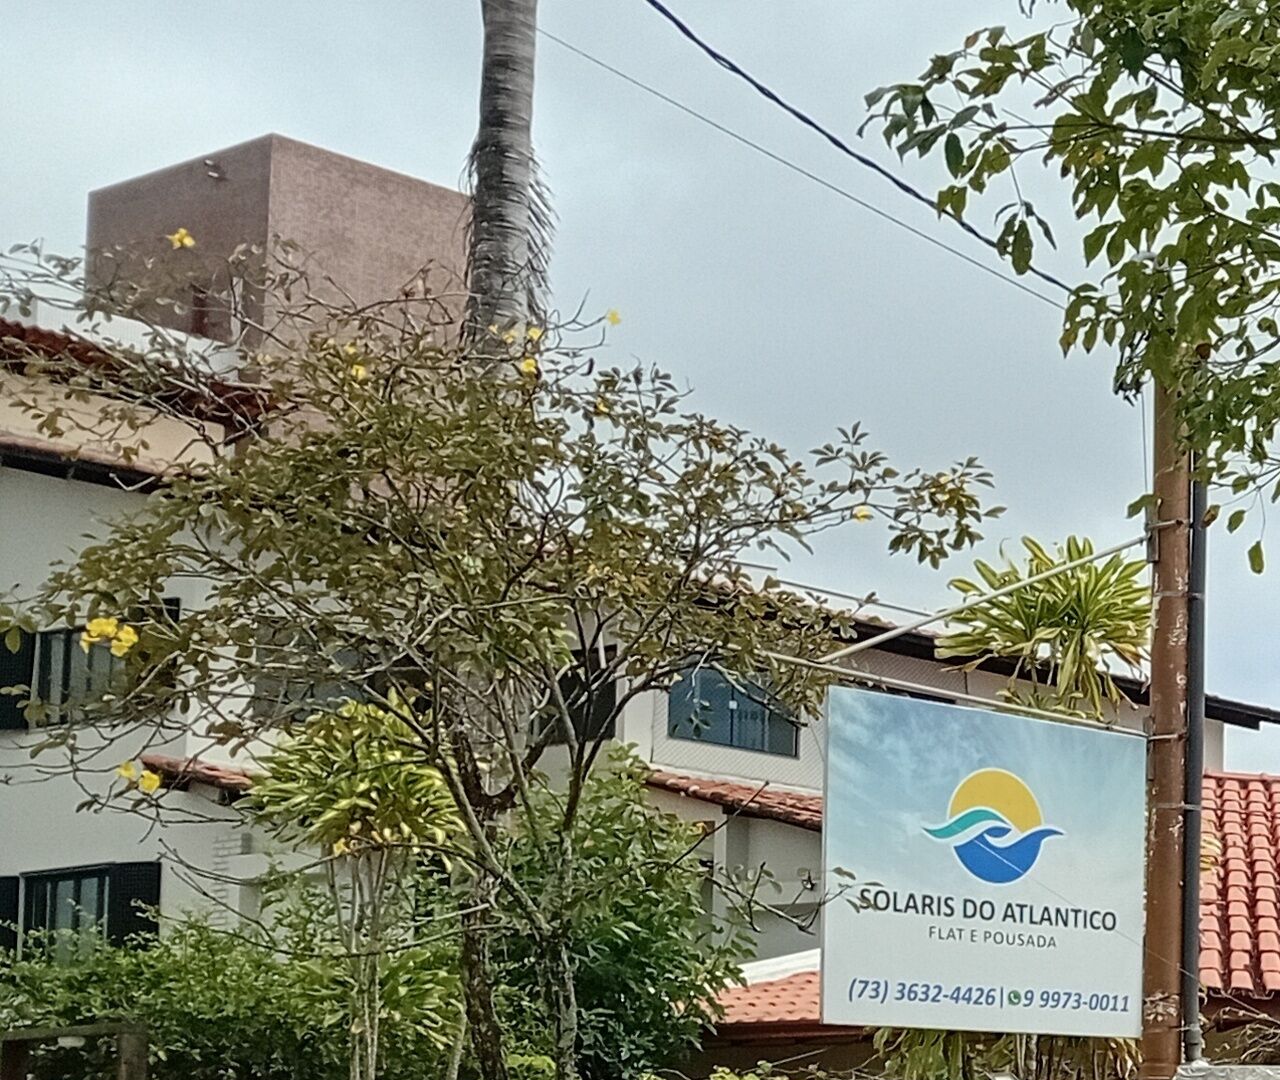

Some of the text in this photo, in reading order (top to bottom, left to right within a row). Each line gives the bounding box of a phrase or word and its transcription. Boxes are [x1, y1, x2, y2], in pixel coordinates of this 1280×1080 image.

[859, 888, 1117, 931] SOLARIS DO ATLANTICO
[928, 925, 1057, 949] FLAT E POUSADA
[849, 977, 888, 1003] (73)
[894, 981, 996, 1006] 3632-4426
[1023, 990, 1034, 1008] 9
[1039, 990, 1130, 1013] 9973-0011
